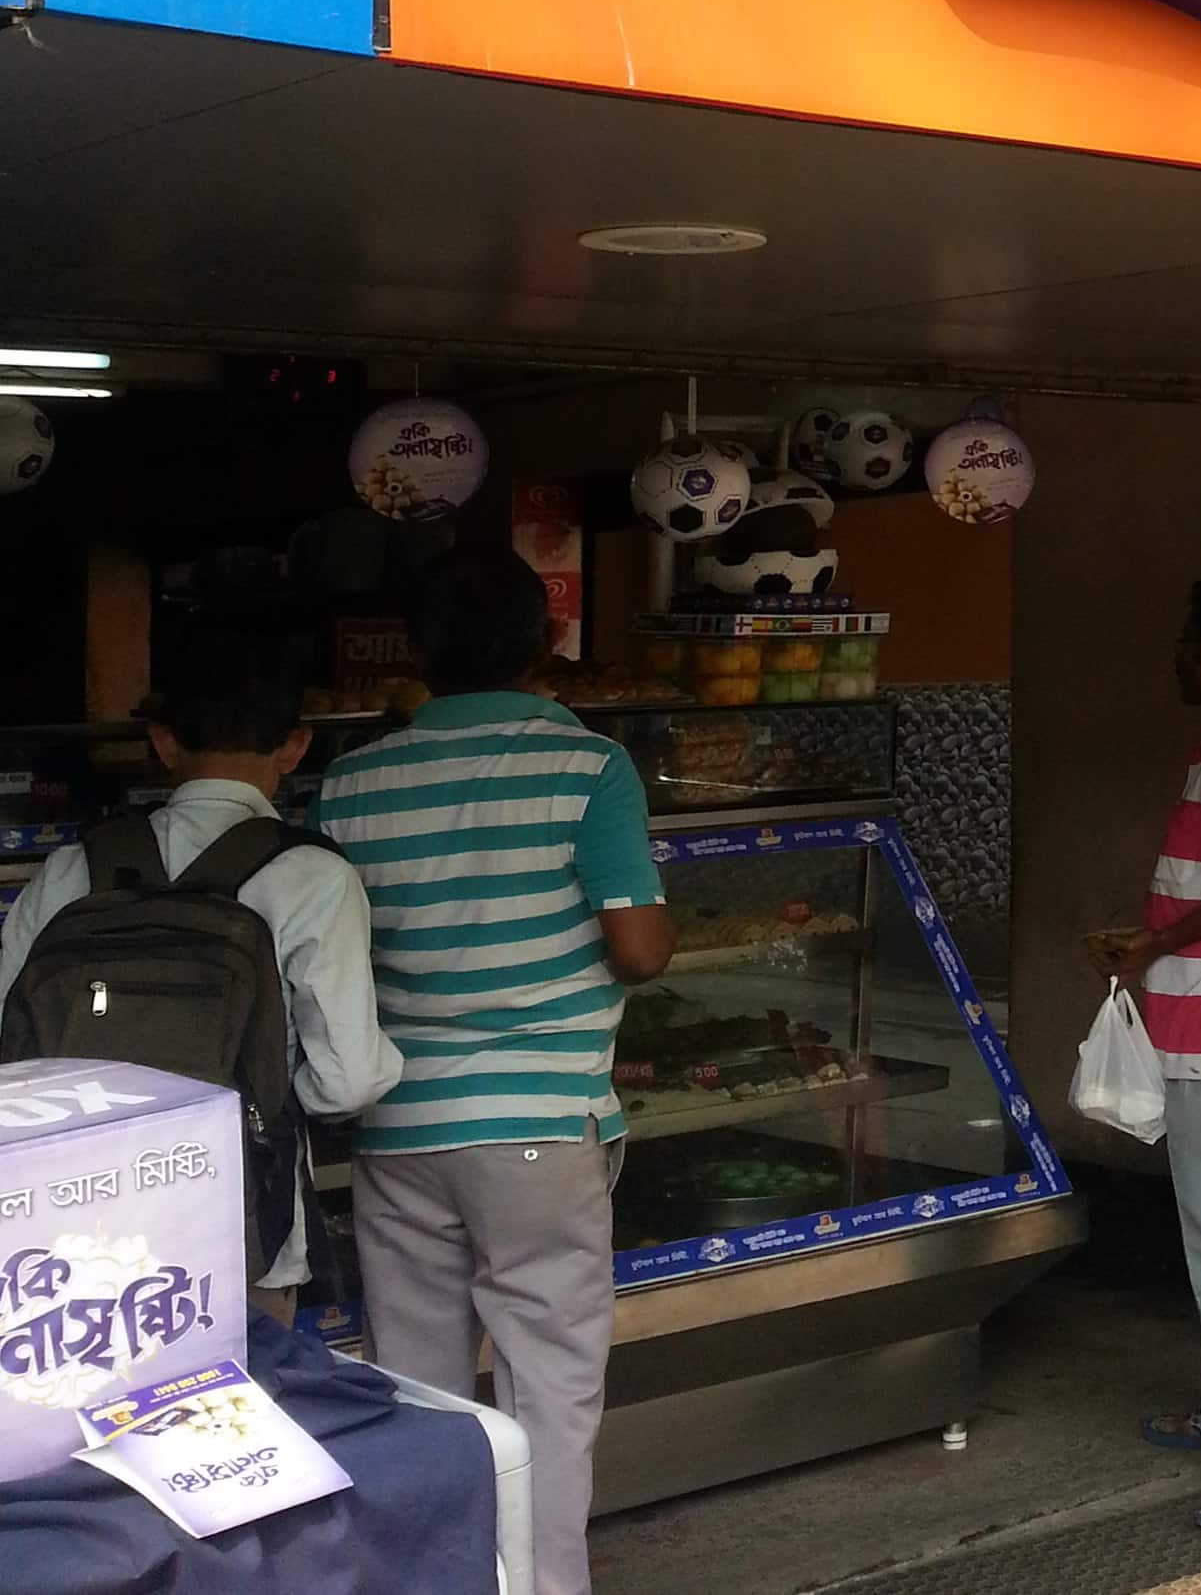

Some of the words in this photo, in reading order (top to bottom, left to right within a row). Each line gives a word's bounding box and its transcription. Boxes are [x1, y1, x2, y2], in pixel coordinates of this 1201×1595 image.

[48, 1168, 120, 1207] আর
[132, 1141, 217, 1192] মিষ্টি,
[0, 1248, 72, 1313] কি
[0, 1265, 215, 1376] নাসৃষ্টি!
